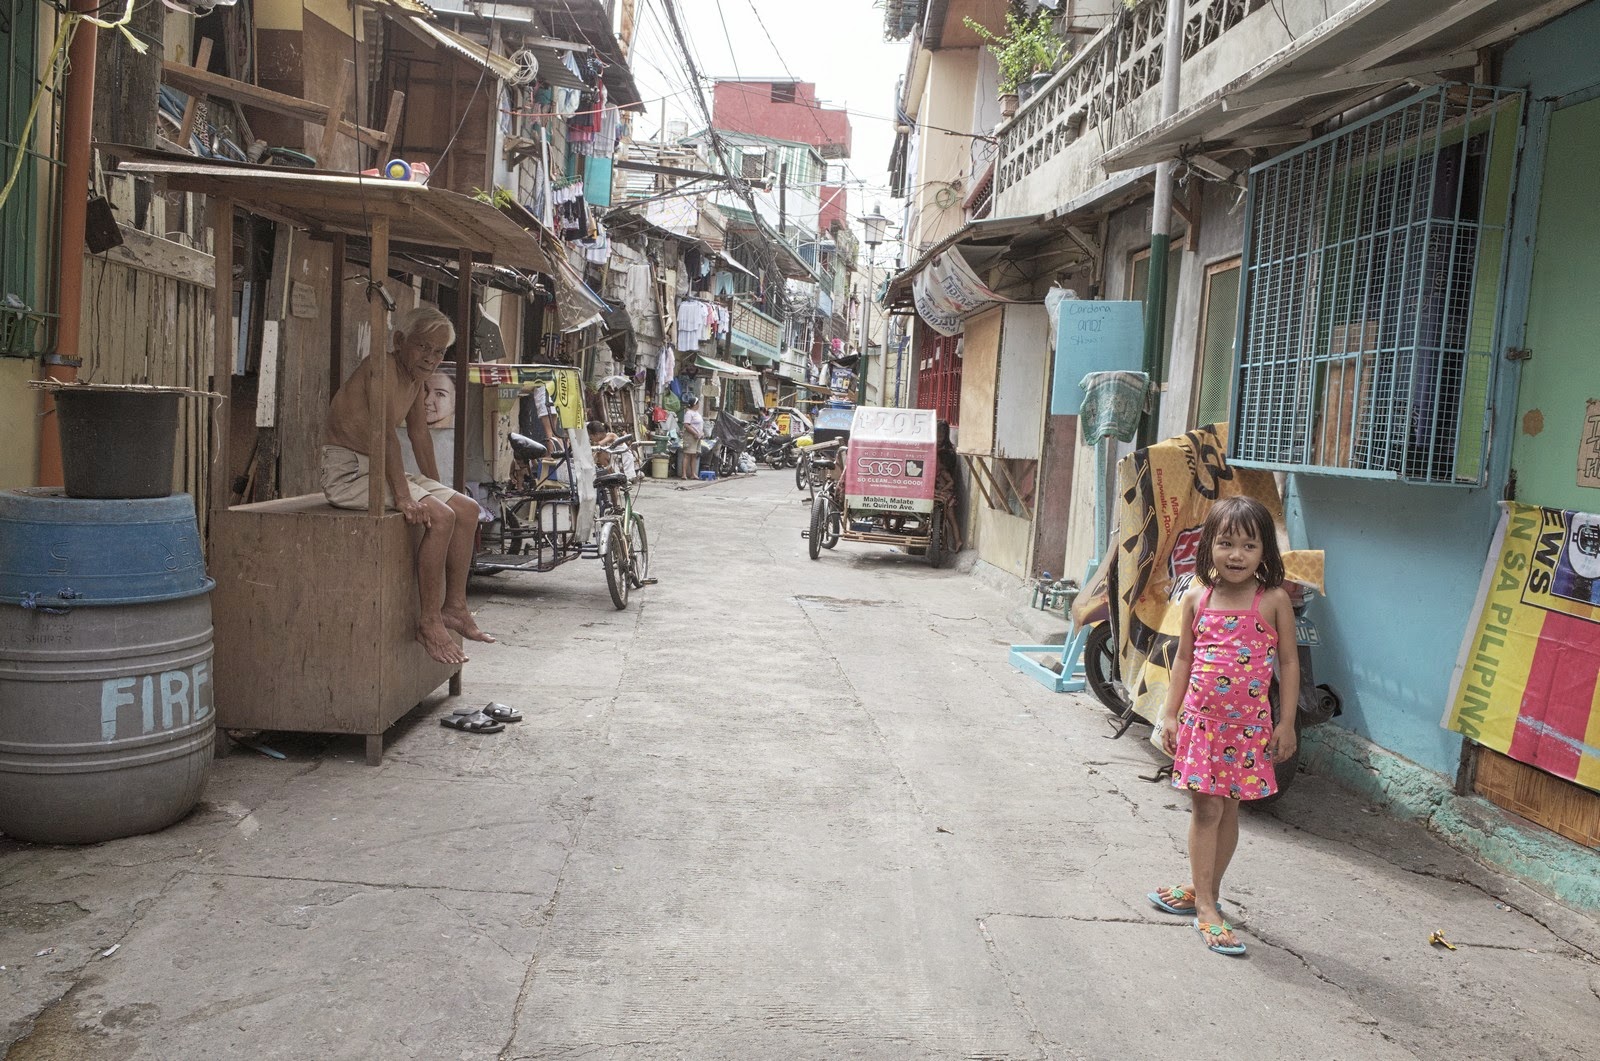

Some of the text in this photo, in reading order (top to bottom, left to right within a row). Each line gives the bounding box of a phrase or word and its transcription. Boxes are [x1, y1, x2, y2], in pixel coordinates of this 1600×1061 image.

[857, 457, 902, 477] SOGO
[863, 496, 888, 504] Mabini,
[872, 502, 898, 510] Quirino
[1496, 549, 1527, 592] SA
[1456, 602, 1513, 740] PILIPINA
[101, 661, 210, 742] FIRE
